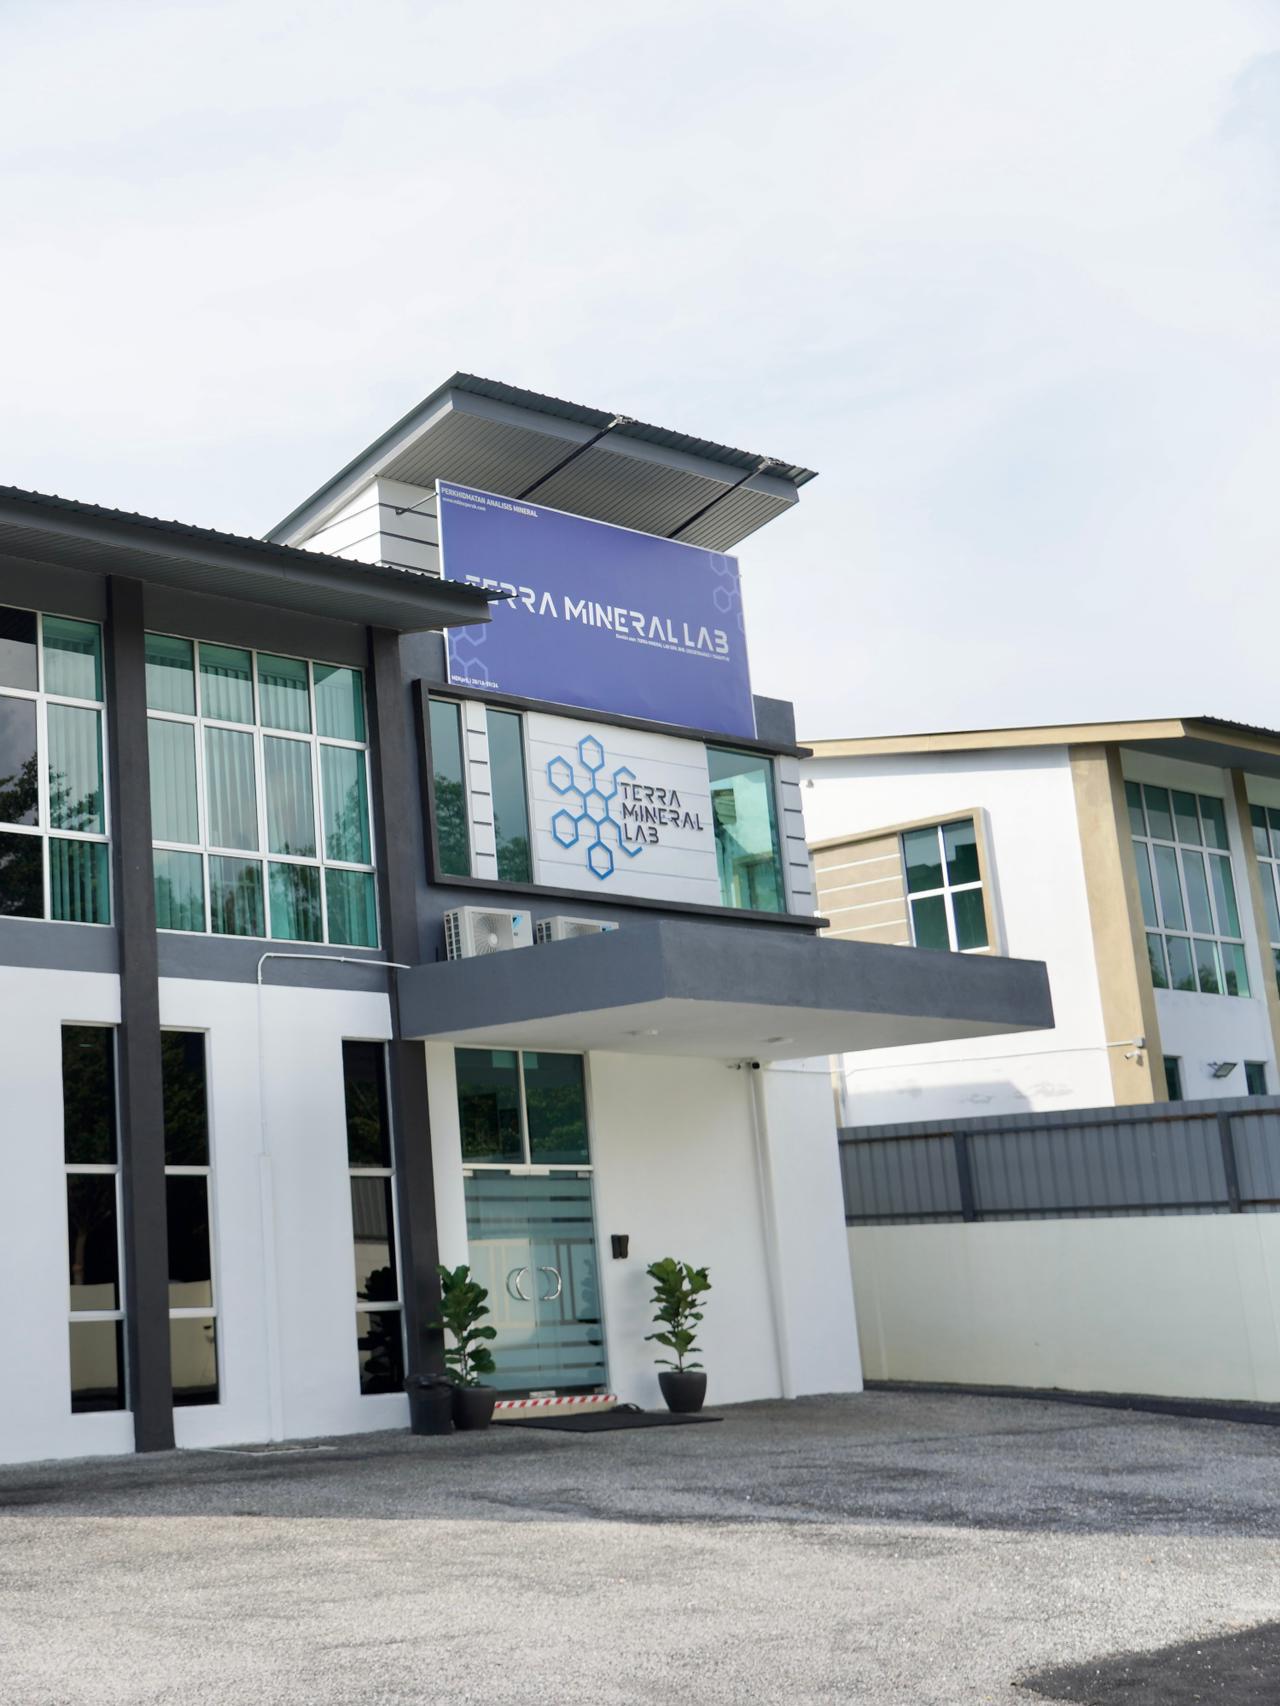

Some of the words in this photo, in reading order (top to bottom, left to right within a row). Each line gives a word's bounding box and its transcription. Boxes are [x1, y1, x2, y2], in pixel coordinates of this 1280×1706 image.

[441, 487, 486, 505] PERKHIDMATAN
[486, 498, 513, 511] ANALISIS
[513, 504, 539, 518] MINERAL
[564, 595, 678, 643] MINERAL
[683, 622, 729, 654] LAB
[621, 782, 681, 808] TERRA
[622, 802, 704, 831] MINERAL
[624, 823, 660, 844] LAB
